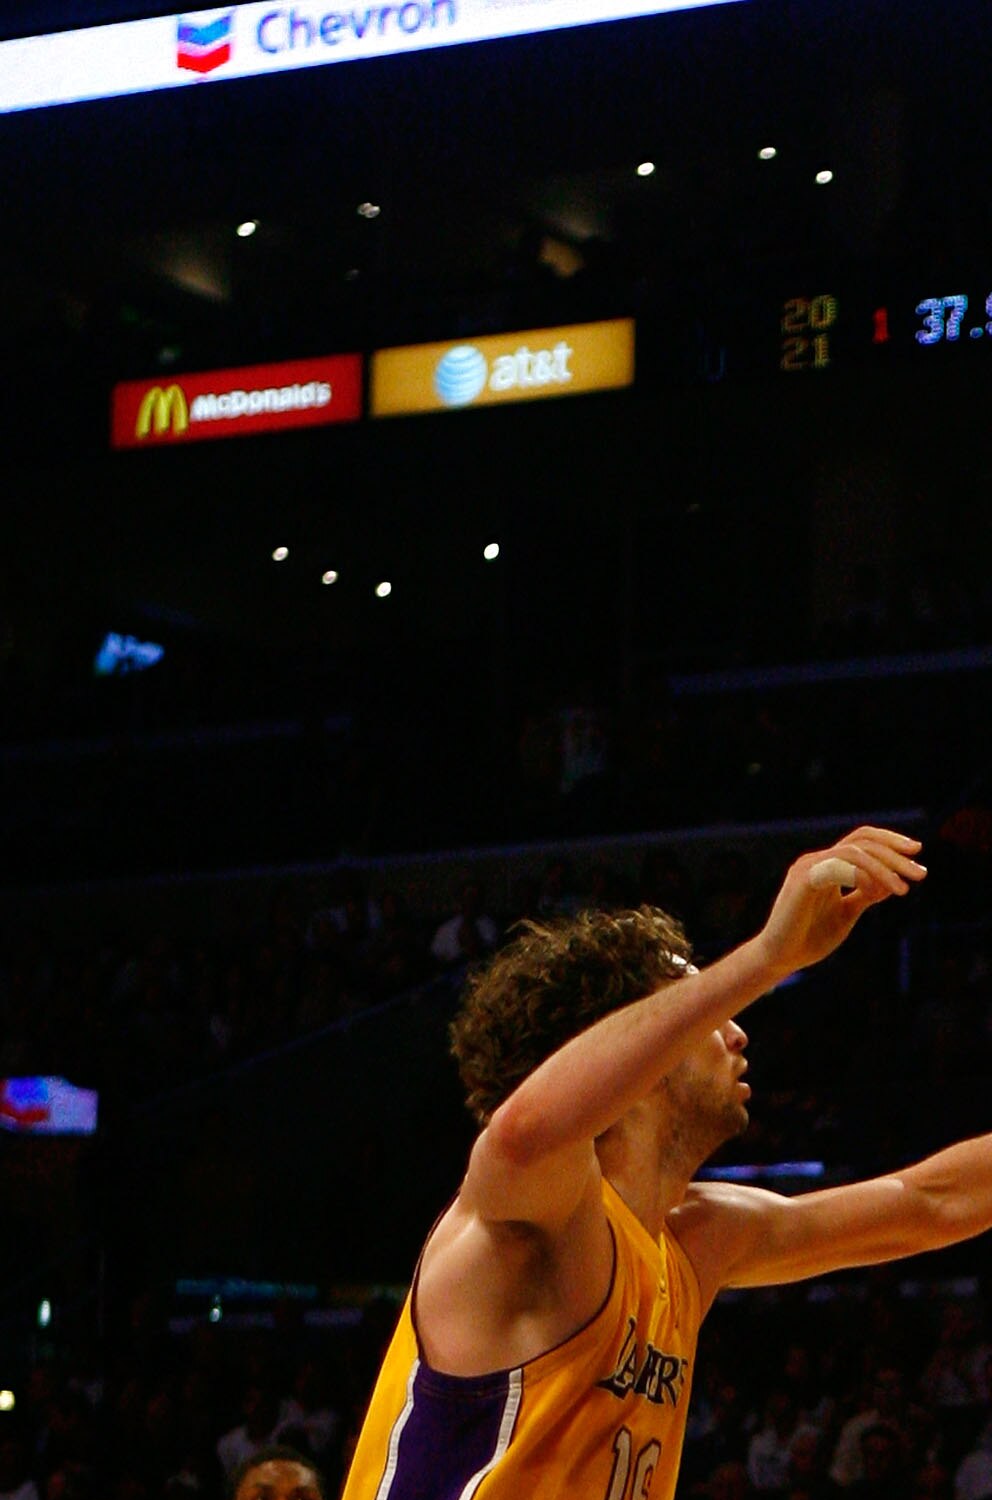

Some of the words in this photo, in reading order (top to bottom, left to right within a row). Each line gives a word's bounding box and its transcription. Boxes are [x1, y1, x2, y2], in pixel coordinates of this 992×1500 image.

[256, 0, 456, 53] Chevron
[781, 294, 838, 335] 20
[489, 342, 573, 391] at&t
[781, 332, 831, 372] 21
[596, 1316, 688, 1408] LAR
